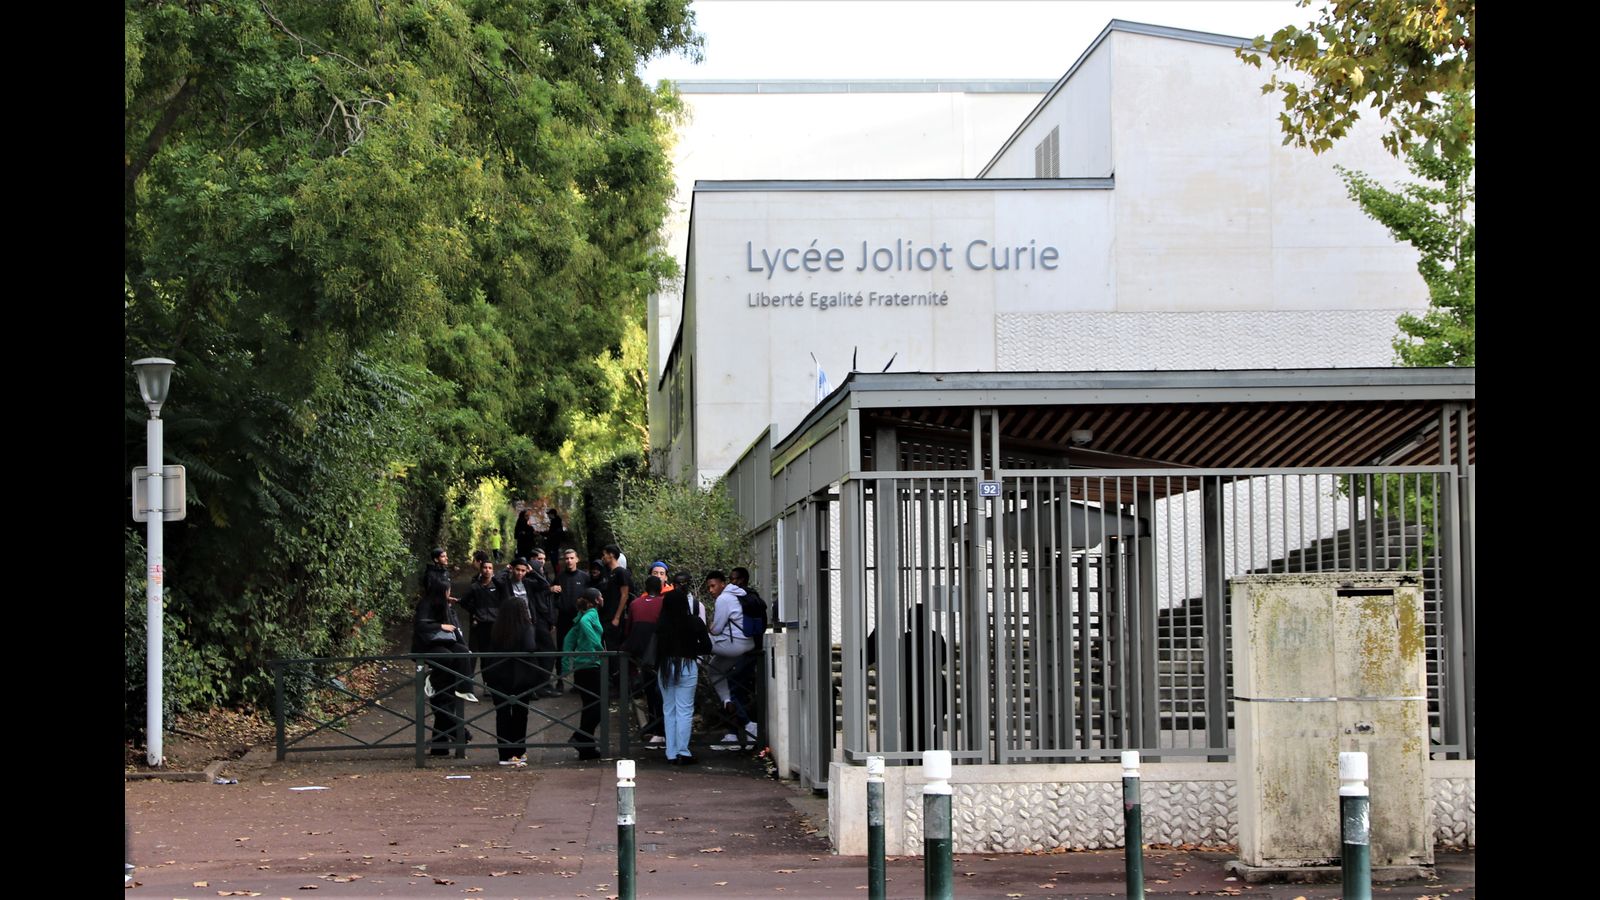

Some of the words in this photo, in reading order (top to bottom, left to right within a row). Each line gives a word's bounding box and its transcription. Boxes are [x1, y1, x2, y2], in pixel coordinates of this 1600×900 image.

[747, 238, 845, 280] Lycée
[856, 238, 954, 272] Joliot
[965, 239, 1060, 271] Curie
[748, 292, 805, 308] Liberté
[810, 291, 864, 311] Egalité
[869, 290, 949, 306] Fraternité
[983, 485, 996, 494] 92
